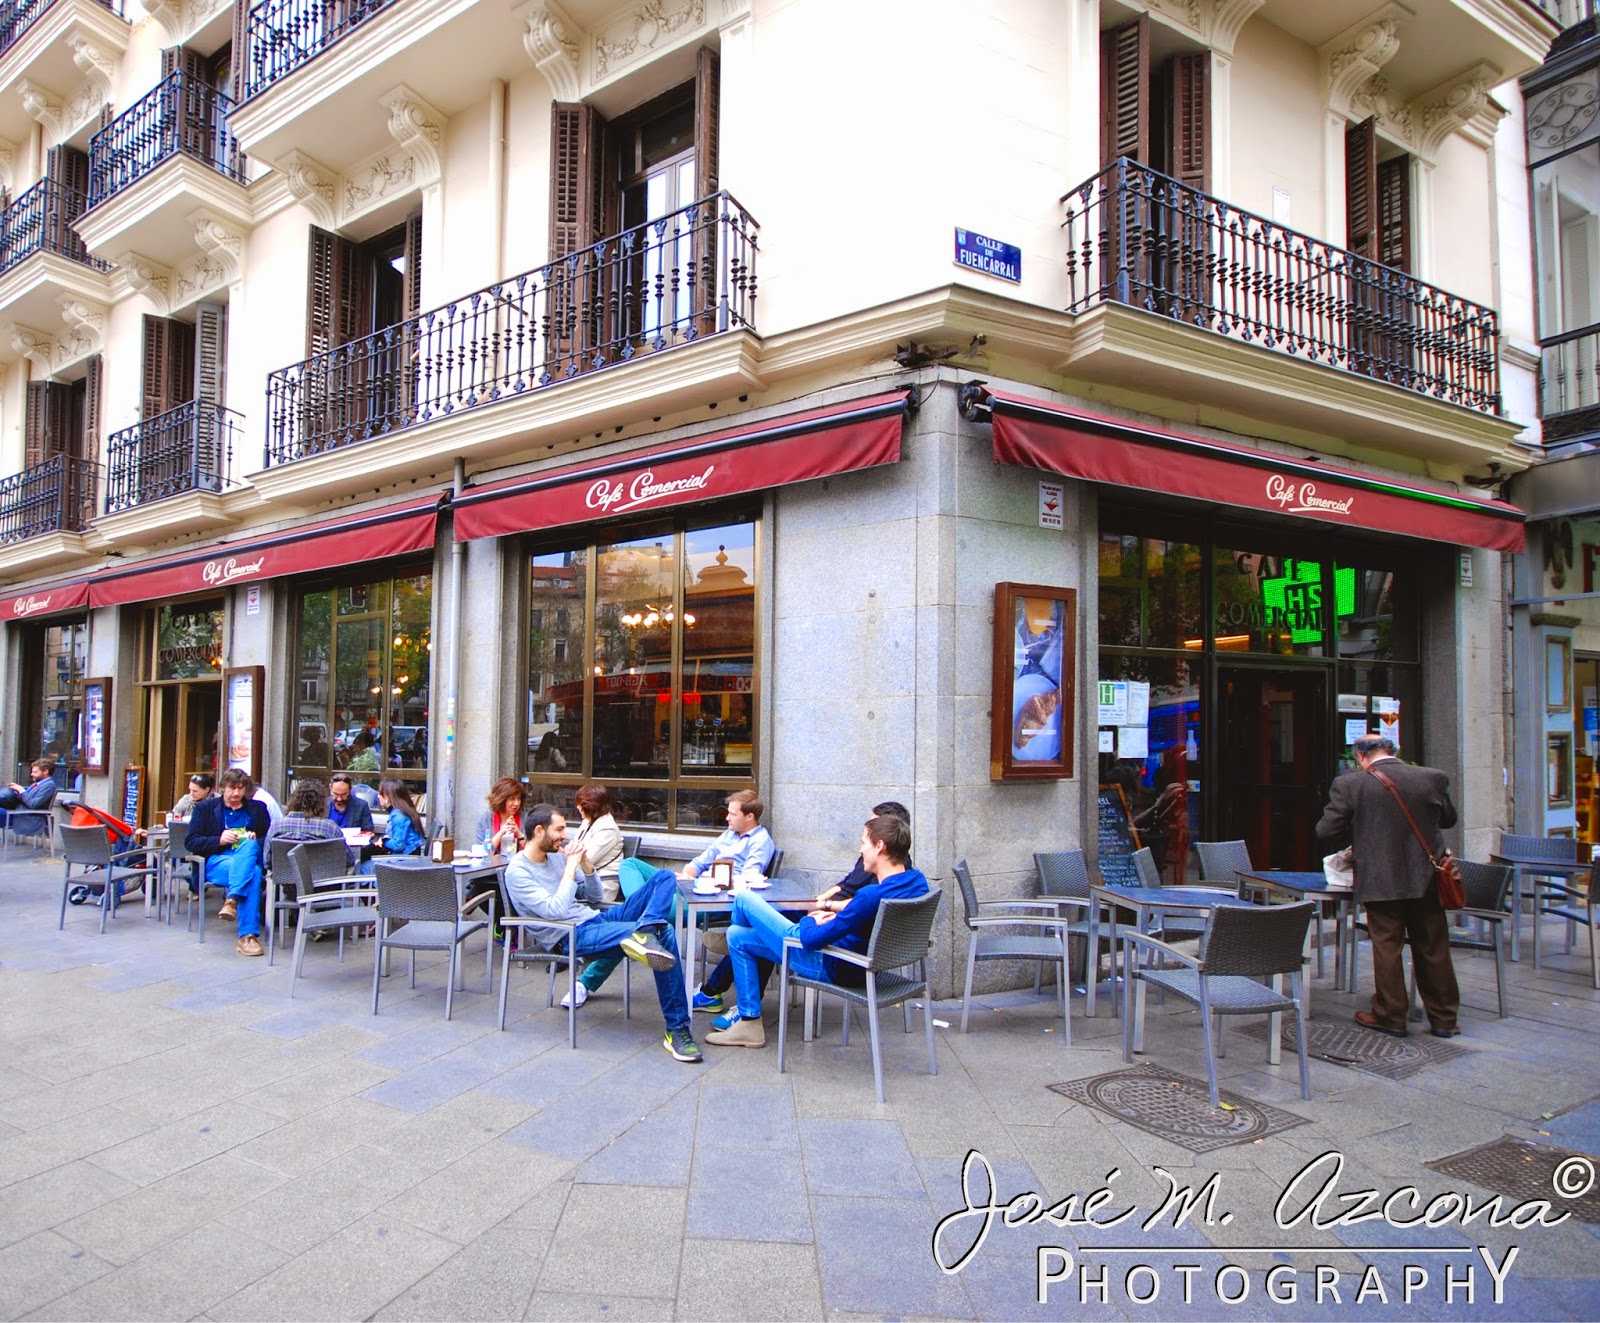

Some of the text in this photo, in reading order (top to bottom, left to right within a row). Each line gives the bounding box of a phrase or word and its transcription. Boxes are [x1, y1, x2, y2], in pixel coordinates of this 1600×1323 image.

[976, 235, 1003, 252] CALLE
[985, 249, 994, 257] DE
[960, 248, 1017, 280] FUENCARRAL
[585, 465, 714, 512] Café Comercial
[1266, 474, 1354, 515] Café Comercial
